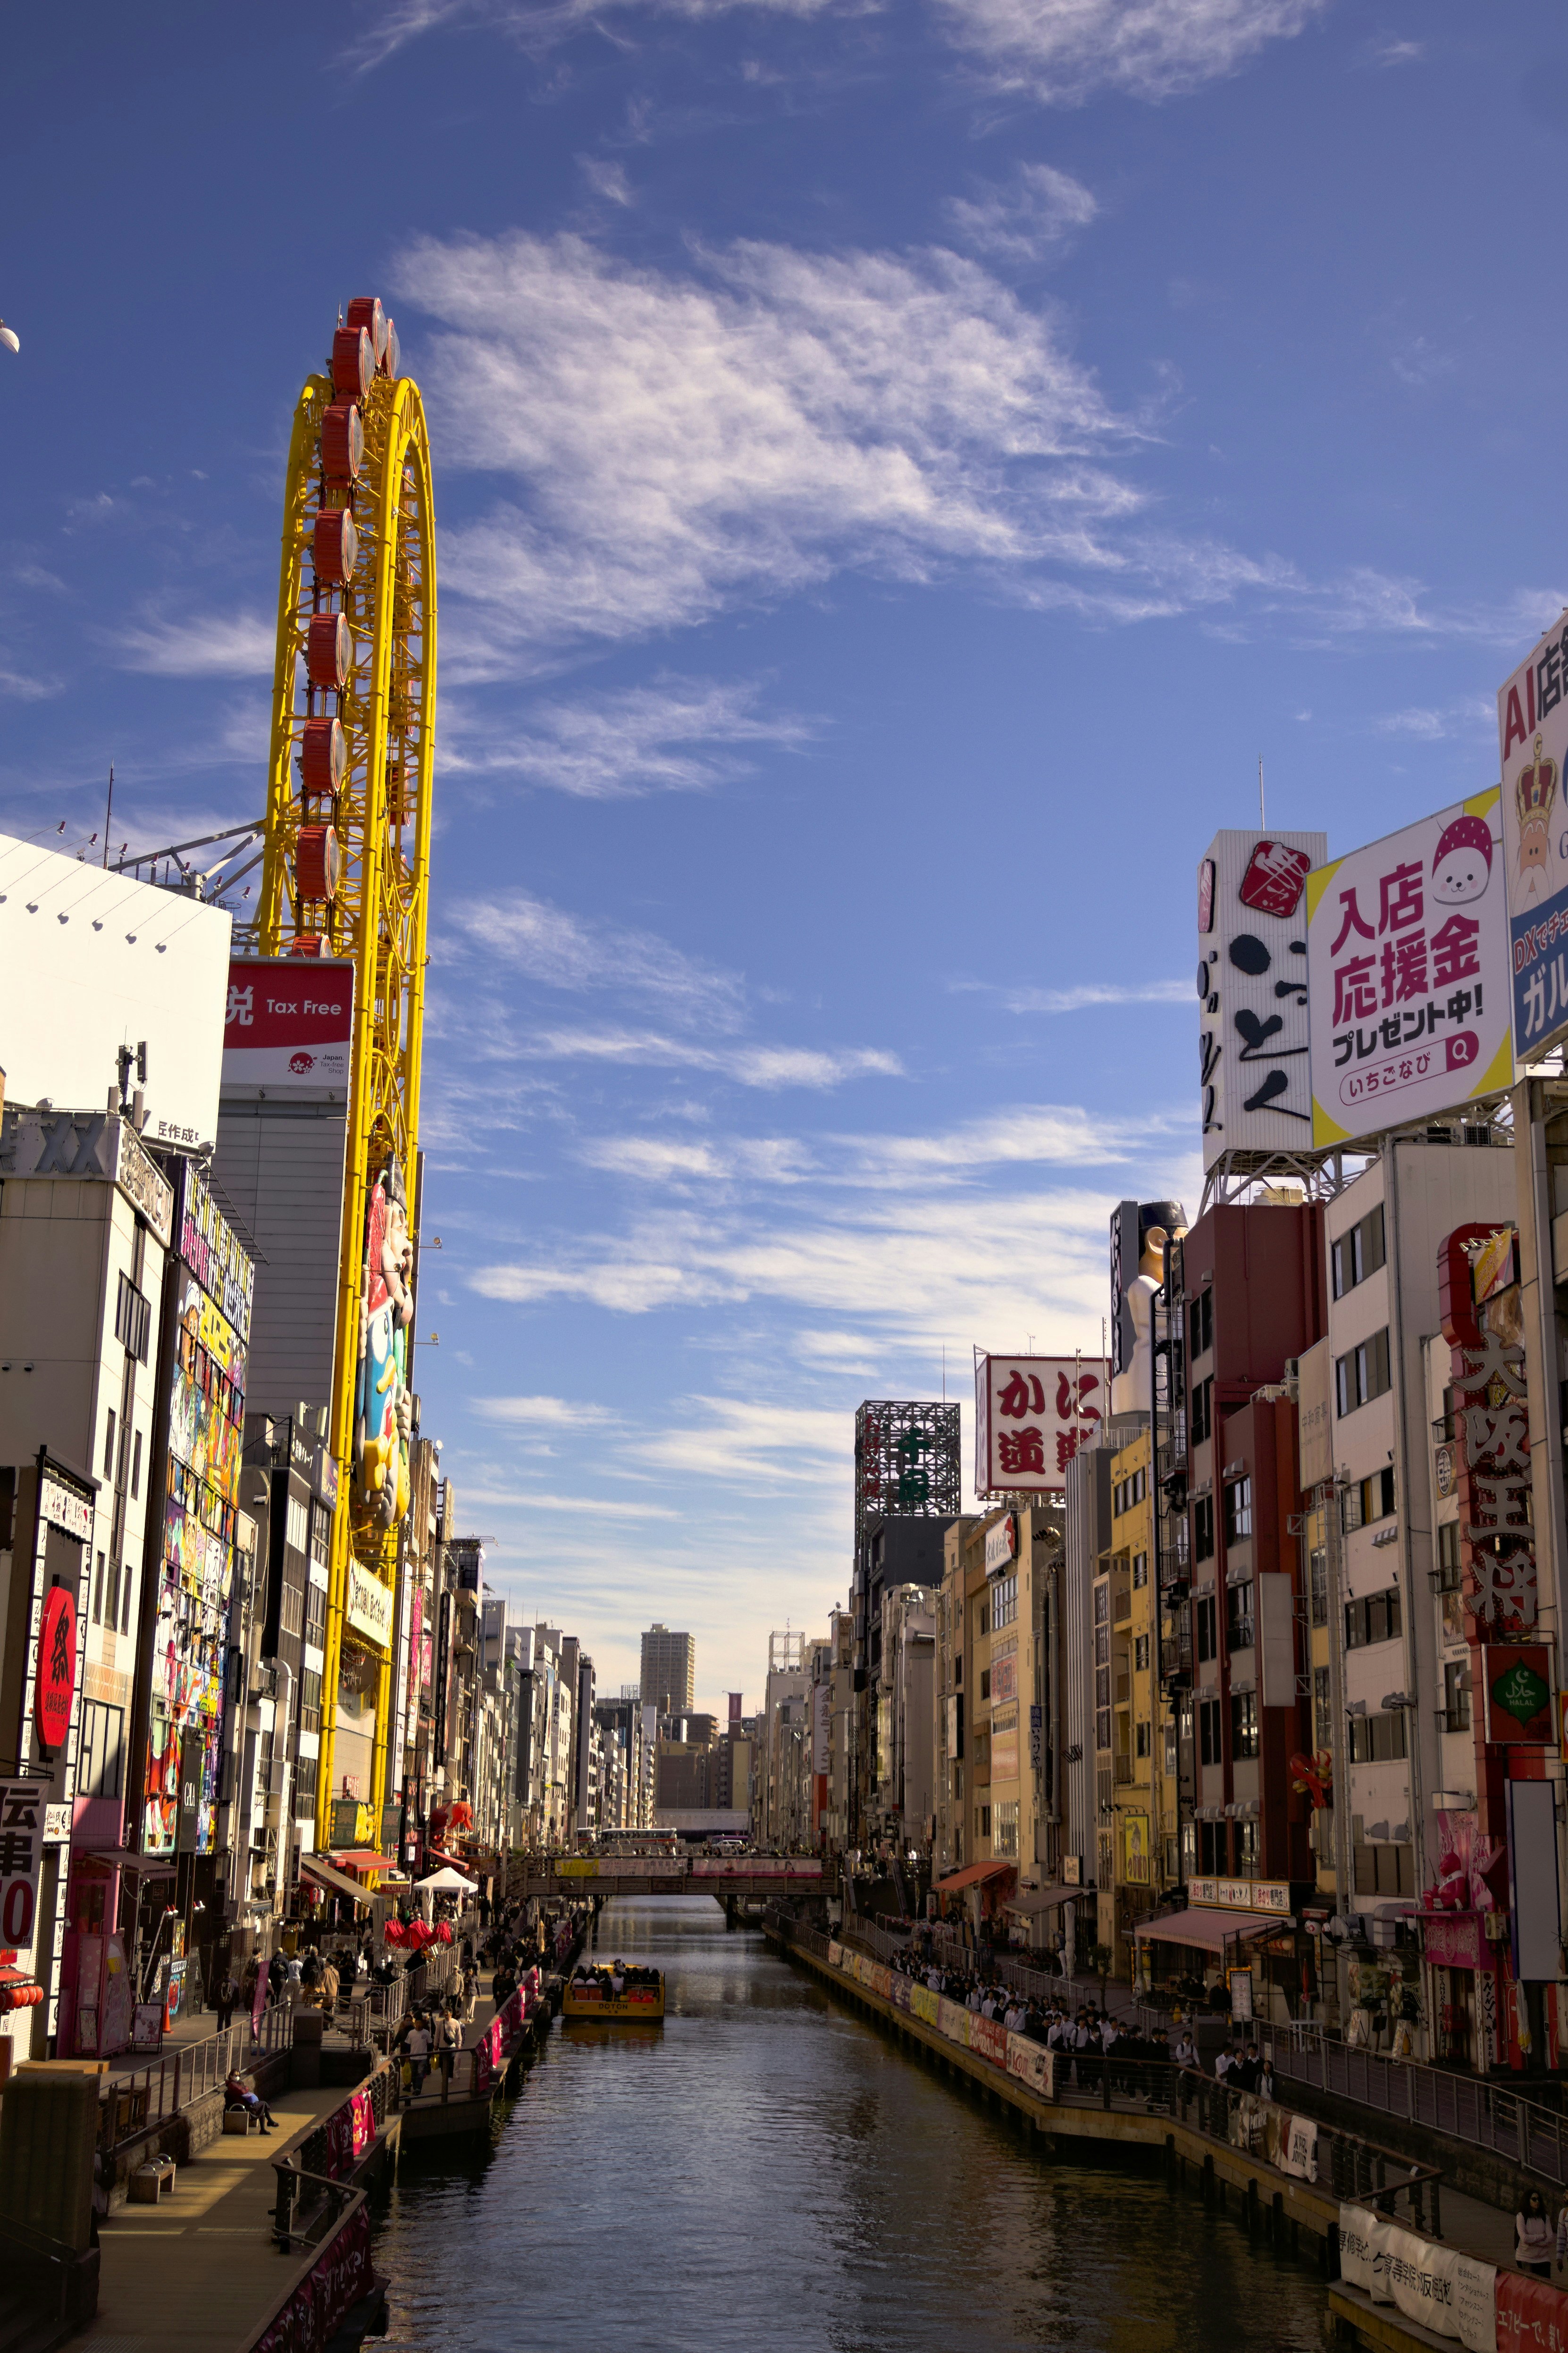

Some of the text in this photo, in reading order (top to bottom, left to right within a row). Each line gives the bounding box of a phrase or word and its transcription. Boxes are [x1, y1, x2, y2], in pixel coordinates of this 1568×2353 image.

[1331, 860, 1424, 959] 入店
[1333, 913, 1480, 1028] 応援金
[267, 999, 342, 1015] Tax Free
[1333, 983, 1483, 1066] プレゼント中!
[1349, 1052, 1430, 1097] いちごなび
[997, 1370, 1101, 1420] かに
[1450, 1333, 1538, 1625] 大阪王将
[1506, 1681, 1535, 1699] حلال
[0, 1879, 34, 1945] 0円
